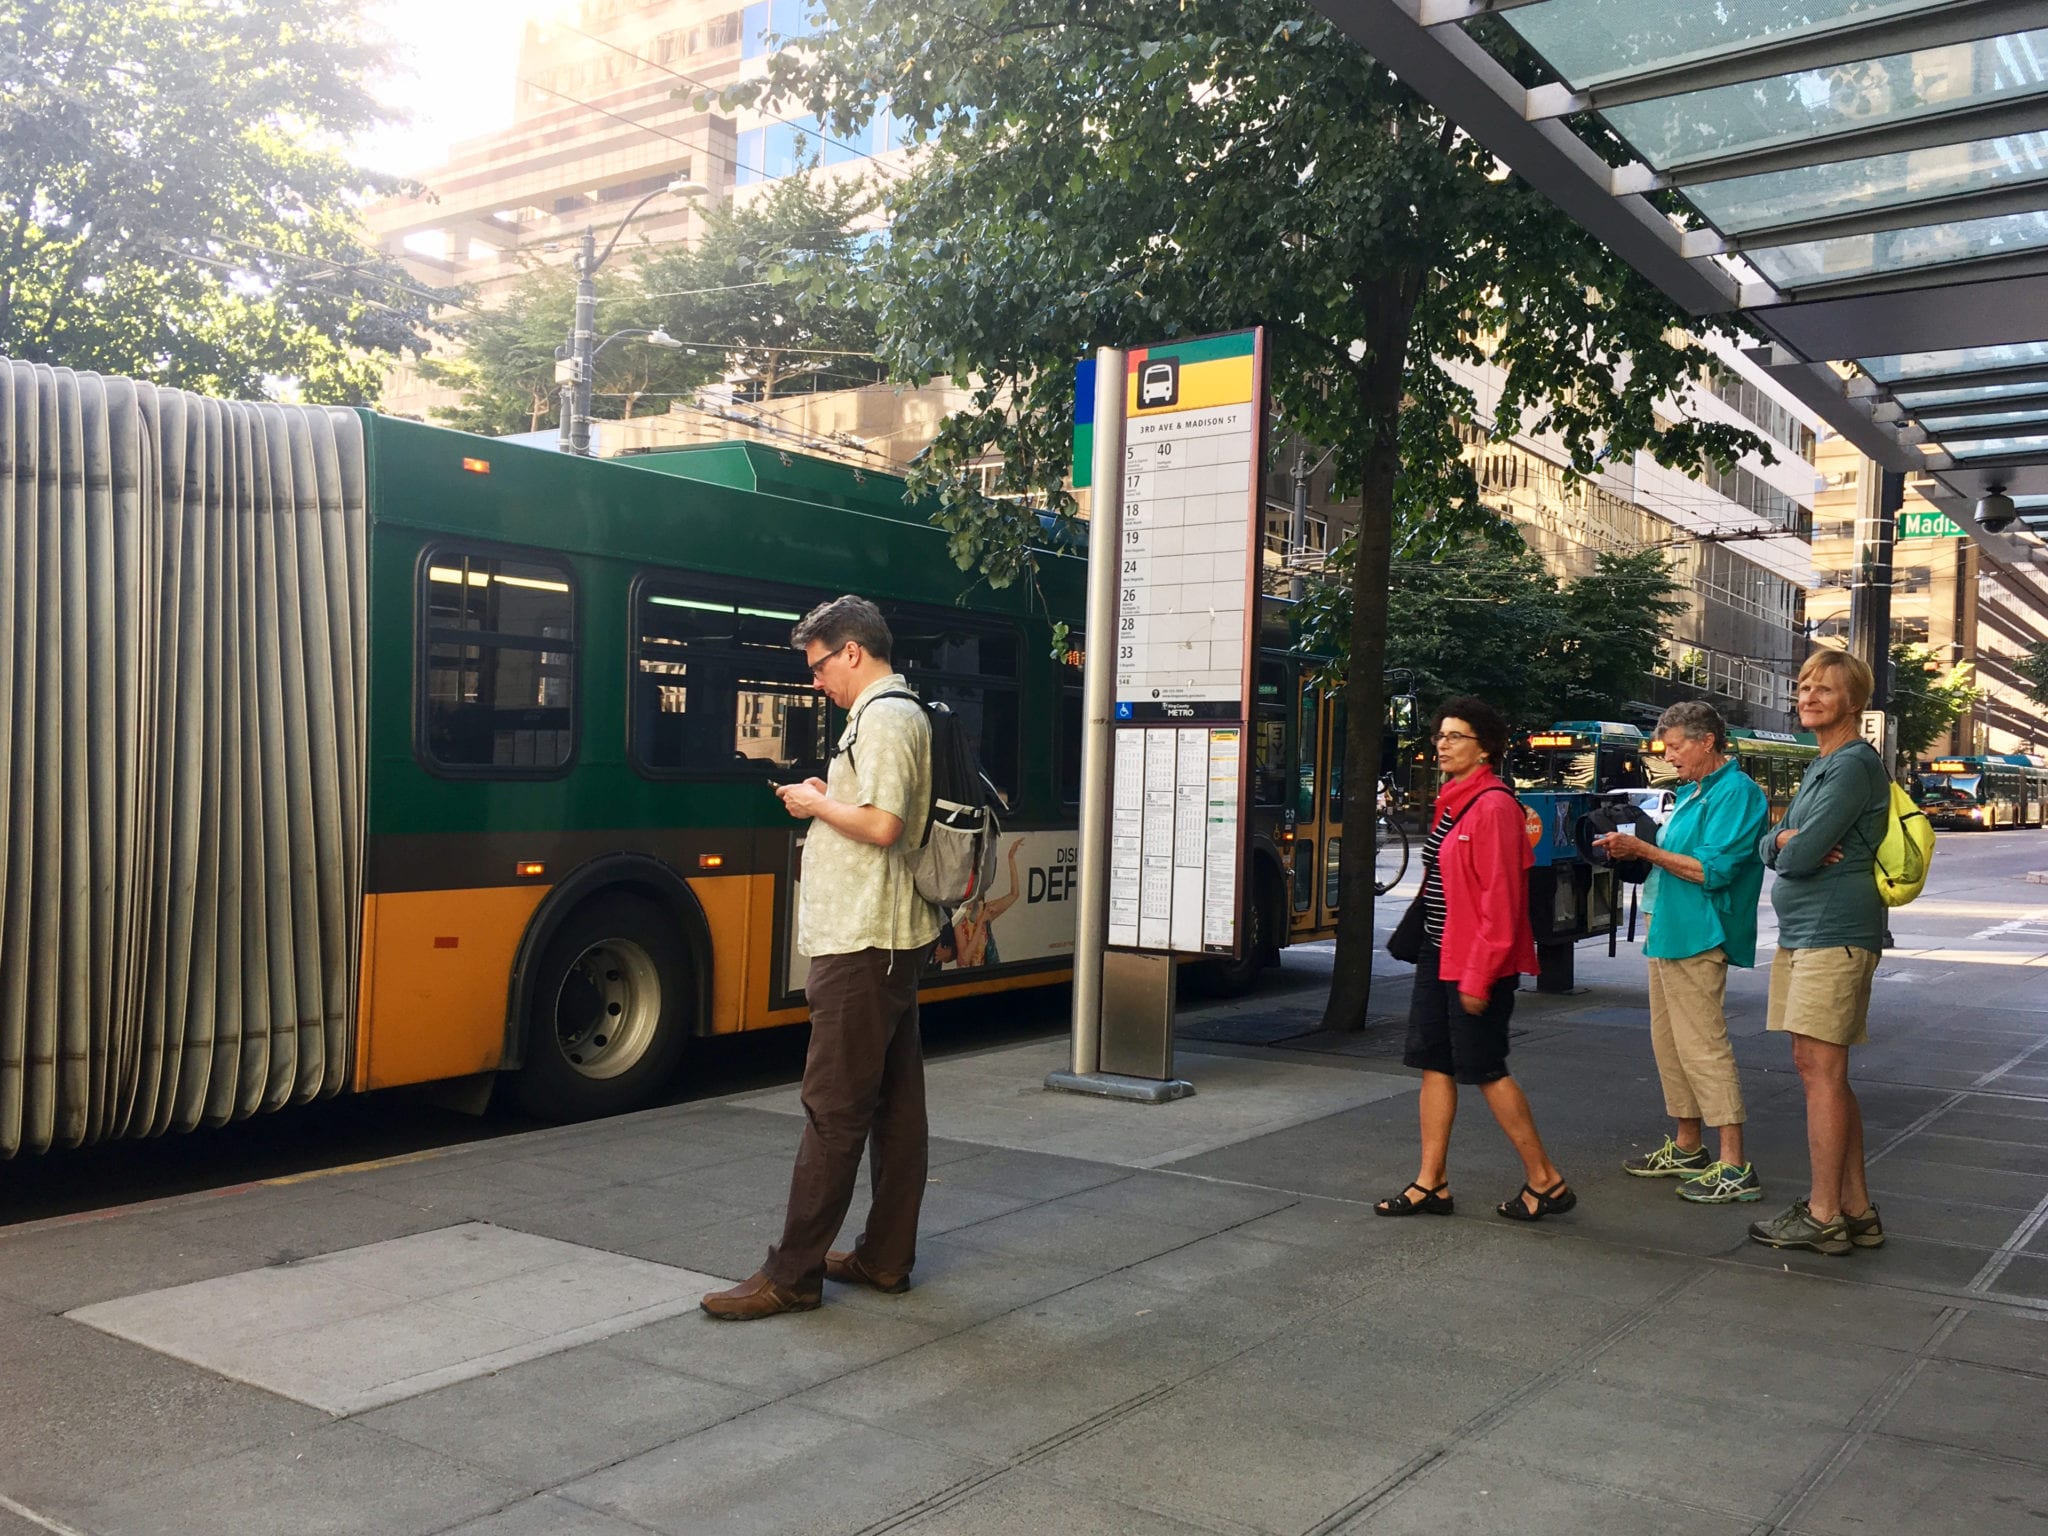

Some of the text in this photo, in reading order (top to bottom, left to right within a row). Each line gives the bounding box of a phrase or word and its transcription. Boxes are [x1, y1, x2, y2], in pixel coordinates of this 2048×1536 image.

[1140, 415, 1237, 434] 3RD AVE & MADISON ST
[1127, 447, 1134, 460] 5
[1157, 443, 1172, 456] 40
[1127, 475, 1140, 488] 17
[1126, 504, 1139, 516] 18
[1126, 531, 1139, 544] 19
[1124, 560, 1137, 573] 24
[1123, 589, 1136, 602] 26
[1121, 618, 1135, 630] 28
[1120, 646, 1133, 659] 33
[1168, 709, 1194, 717] METRO
